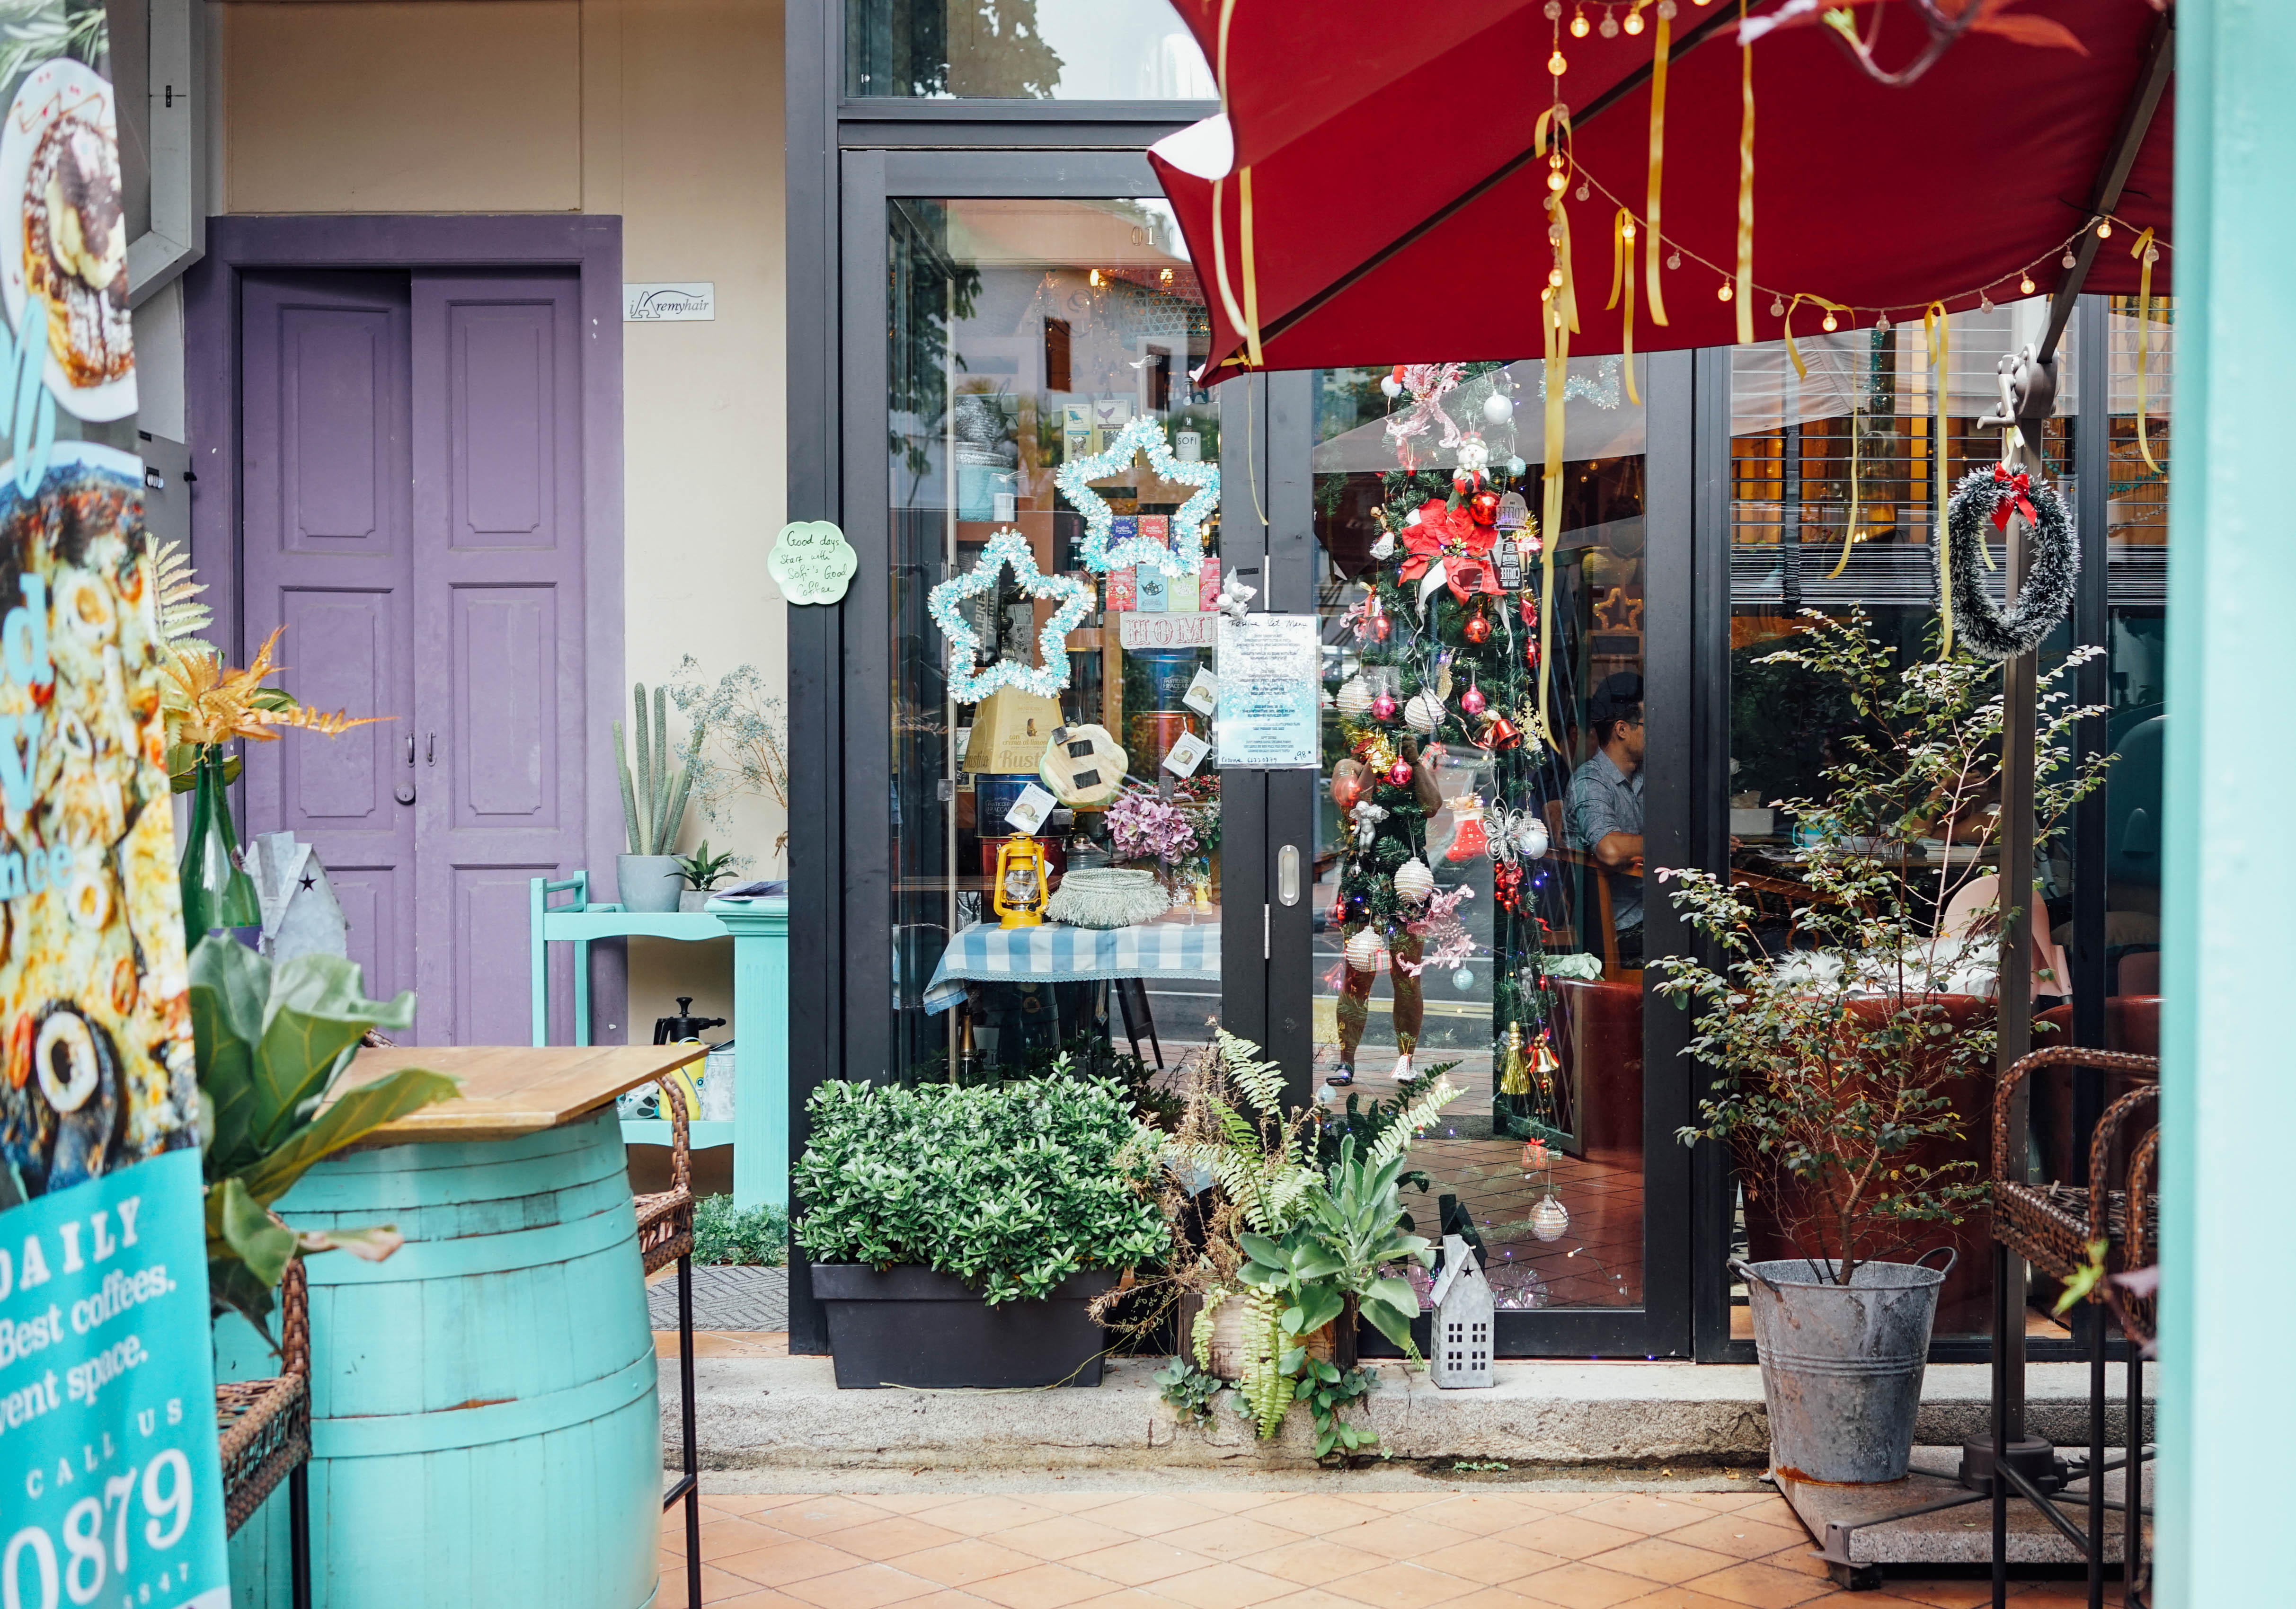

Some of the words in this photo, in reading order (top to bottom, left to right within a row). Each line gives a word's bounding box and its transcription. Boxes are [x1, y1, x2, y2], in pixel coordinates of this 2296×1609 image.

[1178, 437, 1197, 445] SOFI
[787, 530, 813, 546] Good
[820, 535, 839, 553] days
[780, 554, 803, 564] Start
[811, 549, 831, 560] with
[824, 564, 847, 580] Good
[1286, 619, 1308, 628] Menu
[71, 1263, 177, 1335] coffees.
[66, 1335, 148, 1407] space.
[26, 1432, 115, 1500] CALL
[137, 1397, 183, 1437] US
[2, 1448, 193, 1609] 0879
